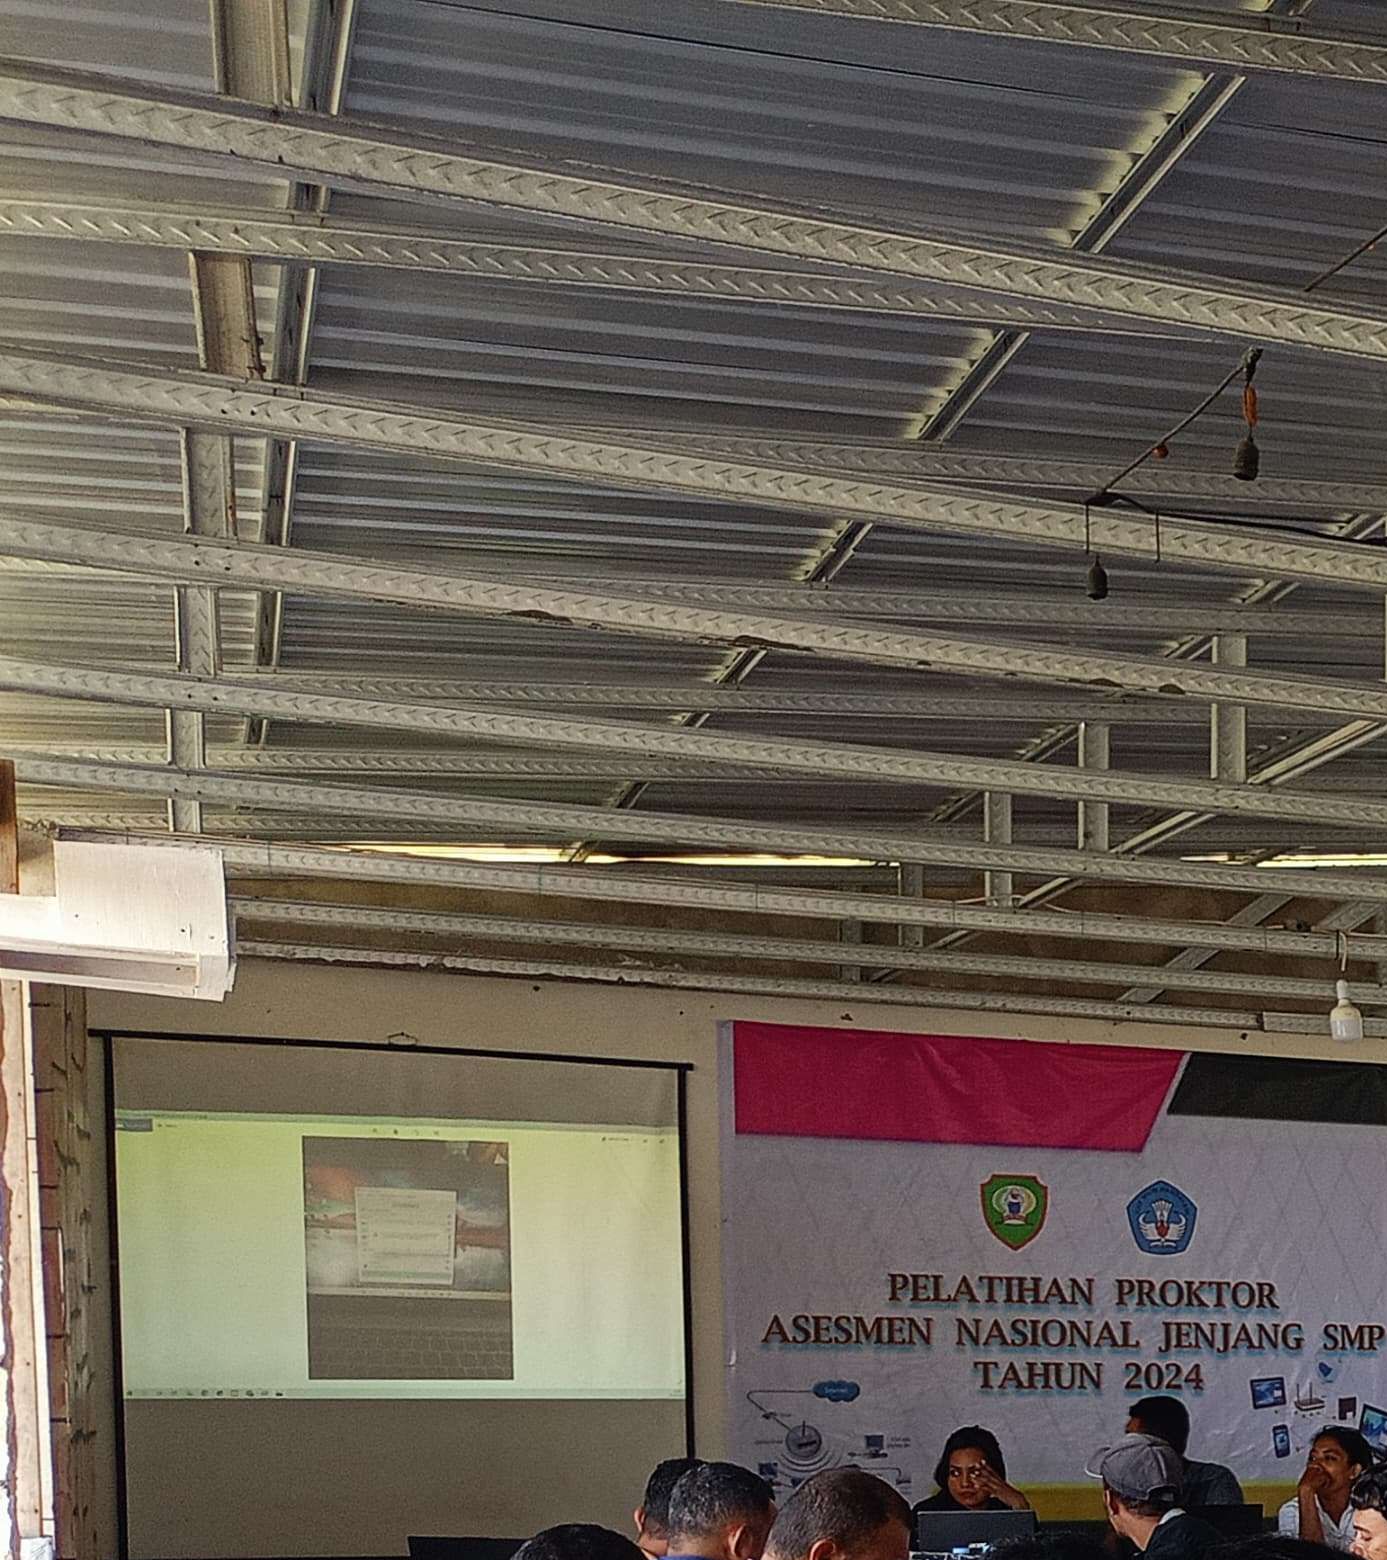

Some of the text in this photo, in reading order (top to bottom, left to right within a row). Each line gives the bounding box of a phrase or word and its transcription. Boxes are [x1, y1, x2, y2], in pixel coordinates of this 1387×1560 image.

[888, 1273, 1280, 1310] PELATIHAN PROKTOR
[761, 1314, 1386, 1353] ASESMEN NASIONAL JENJANG SMP
[973, 1361, 1204, 1391] TAHUN 2024
